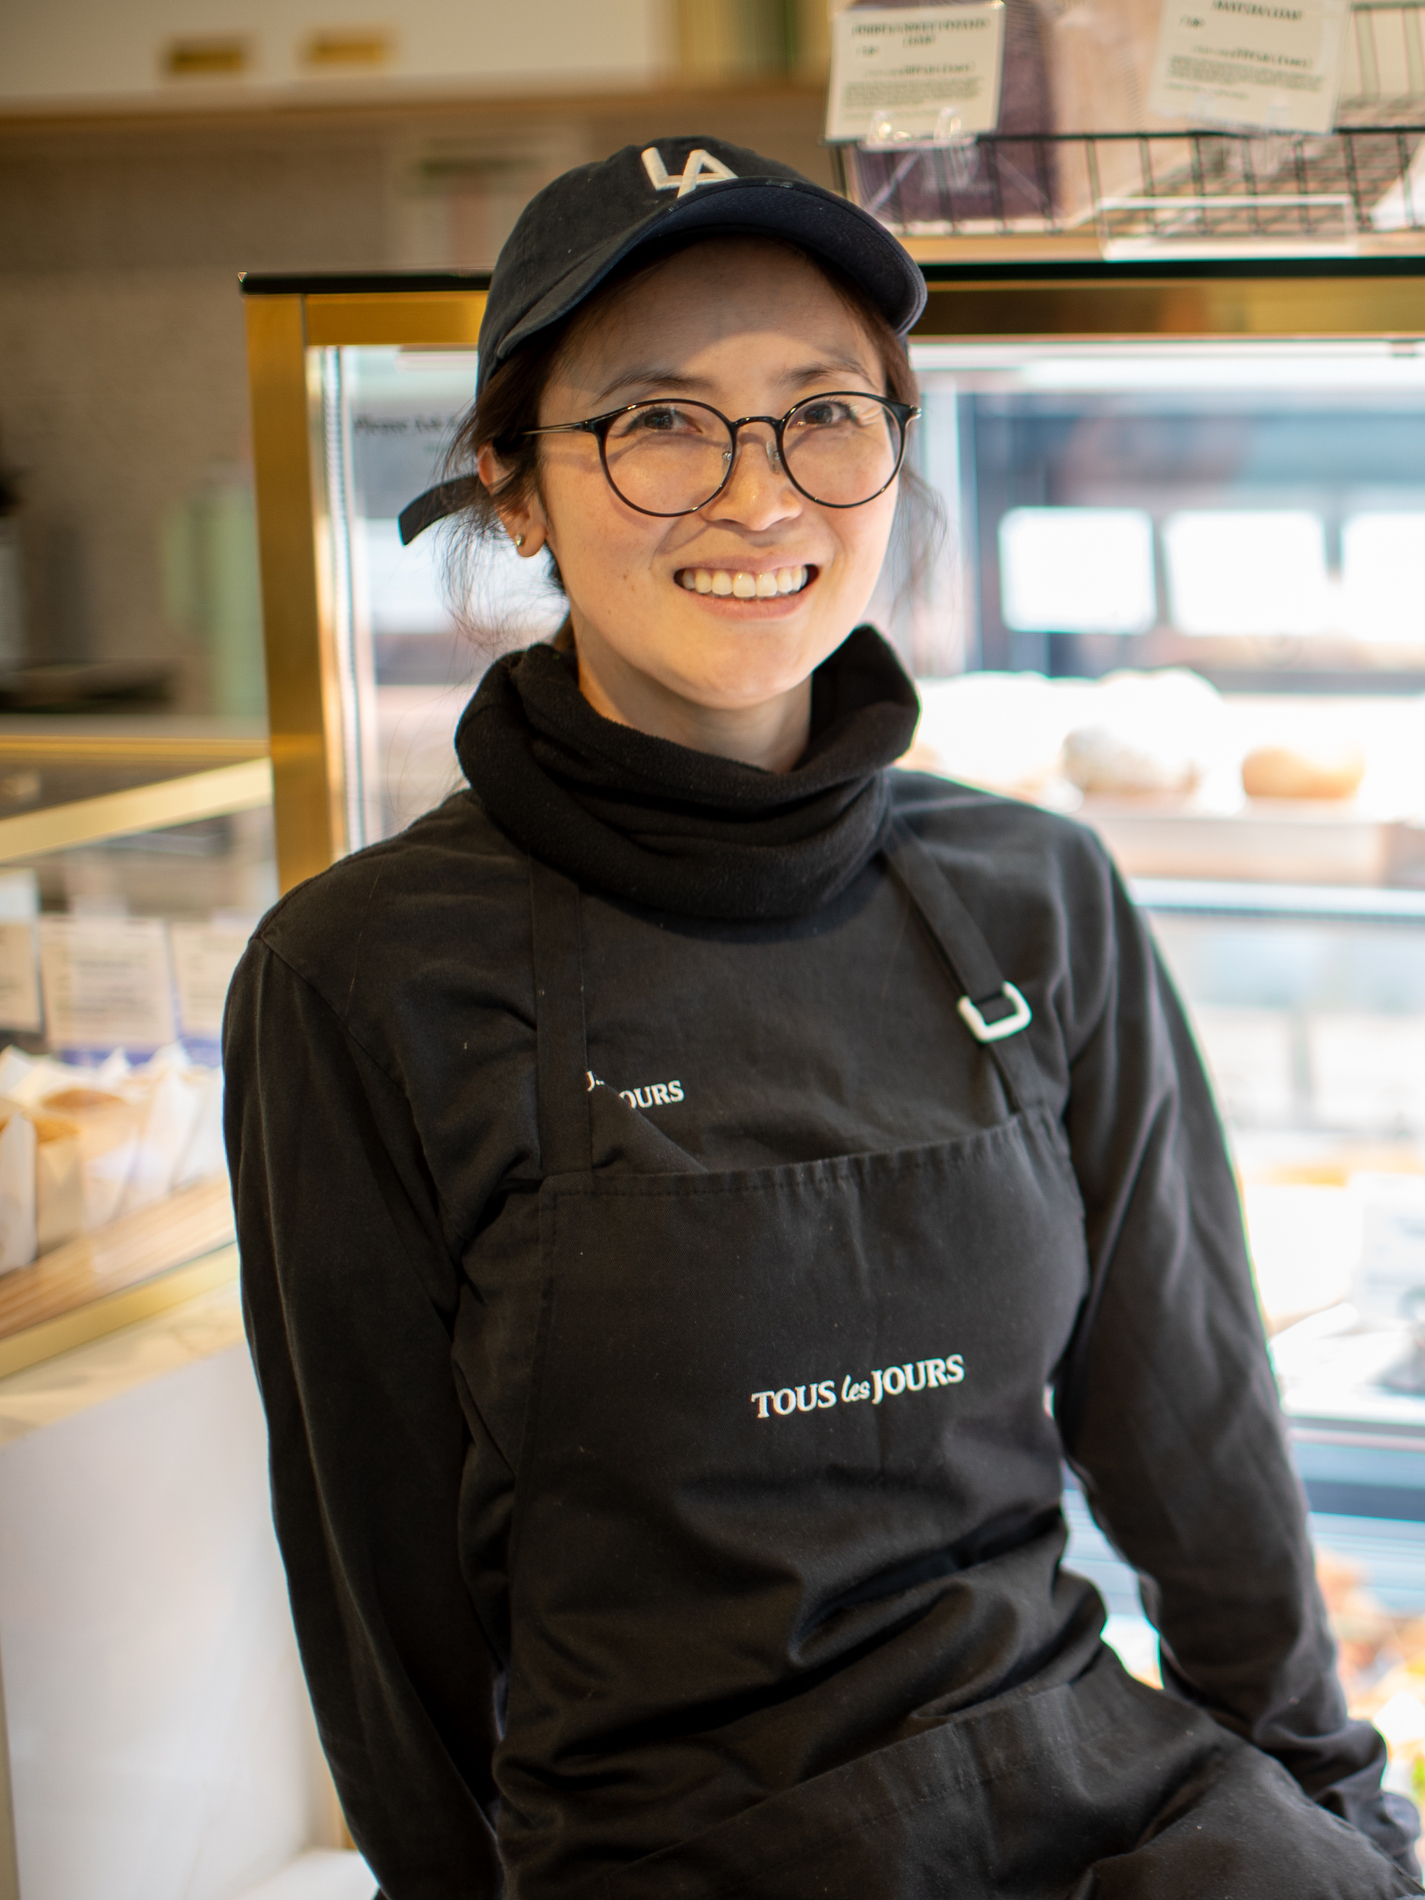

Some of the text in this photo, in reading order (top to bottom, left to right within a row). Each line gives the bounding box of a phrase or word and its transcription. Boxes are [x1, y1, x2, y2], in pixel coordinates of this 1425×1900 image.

[641, 147, 738, 197] LA
[751, 1354, 964, 1418] TOUS les JOURS
